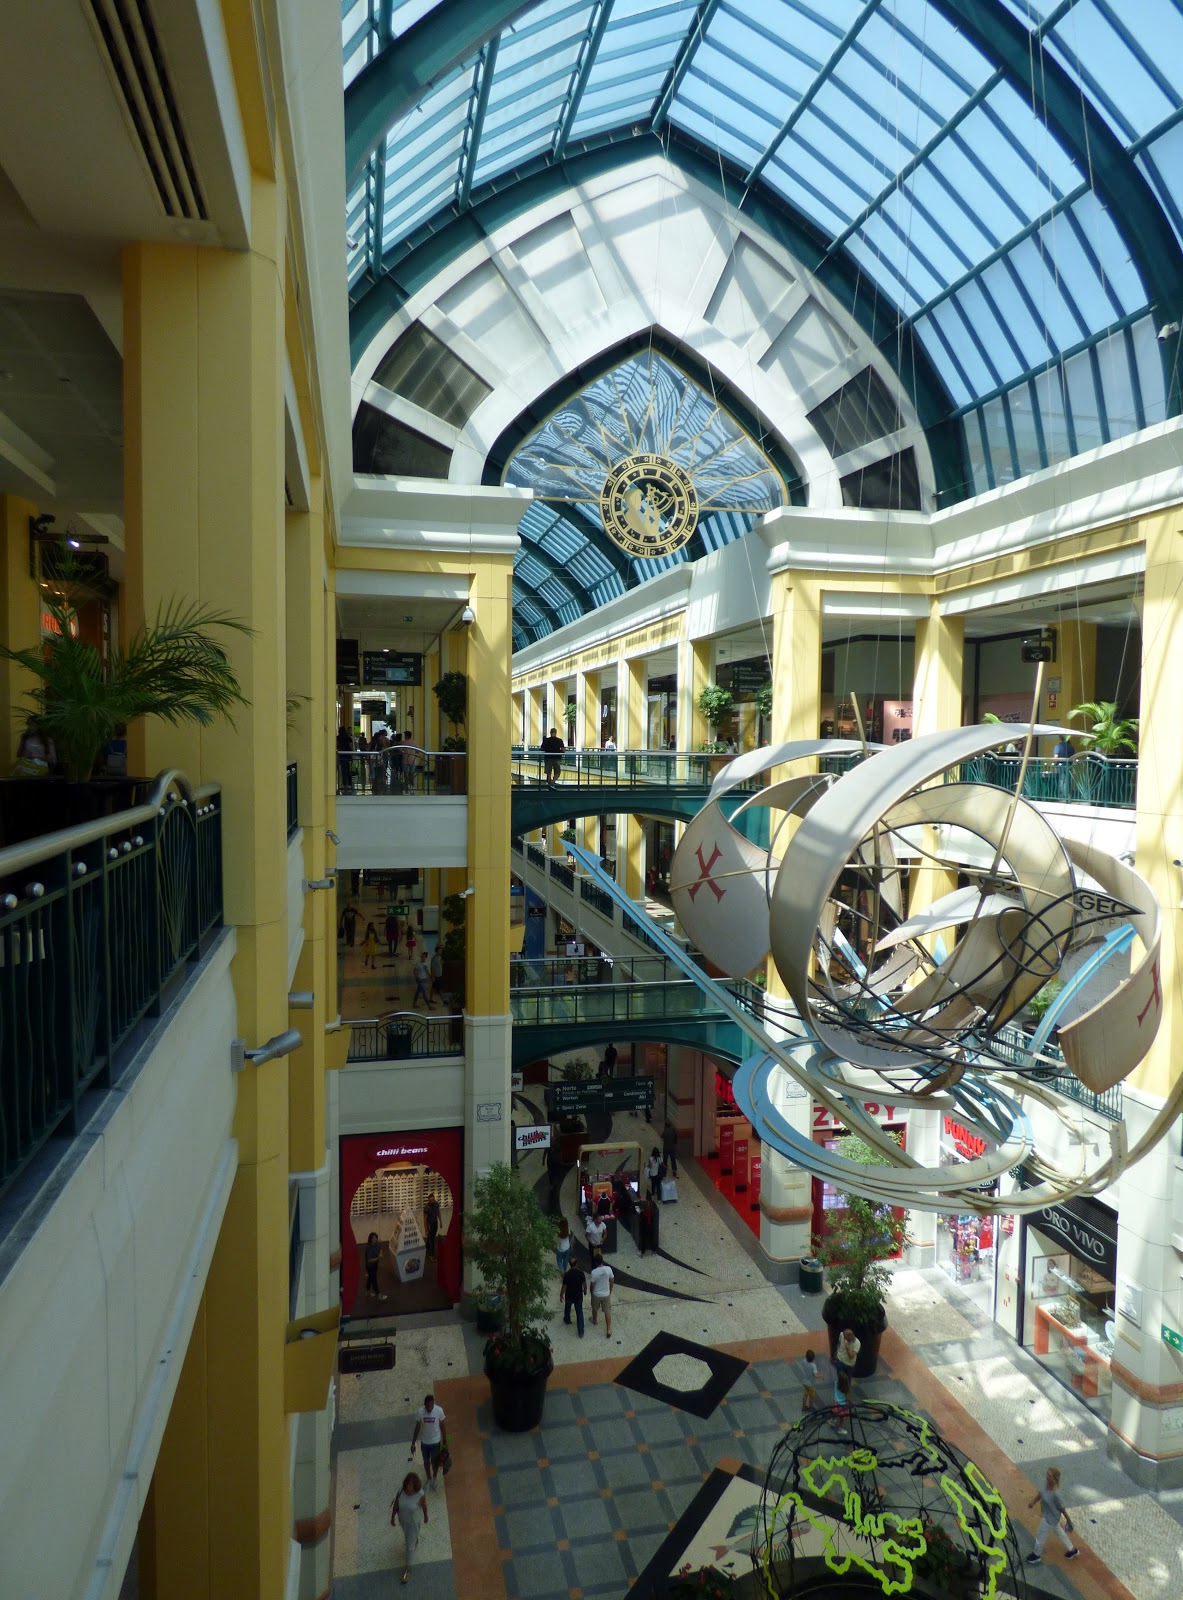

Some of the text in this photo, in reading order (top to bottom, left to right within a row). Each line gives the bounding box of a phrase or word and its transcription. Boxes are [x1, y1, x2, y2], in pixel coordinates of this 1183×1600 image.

[813, 1102, 896, 1127] ZPY
[376, 1148, 399, 1156] chilli
[1042, 1207, 1105, 1257] ORO VIVO
